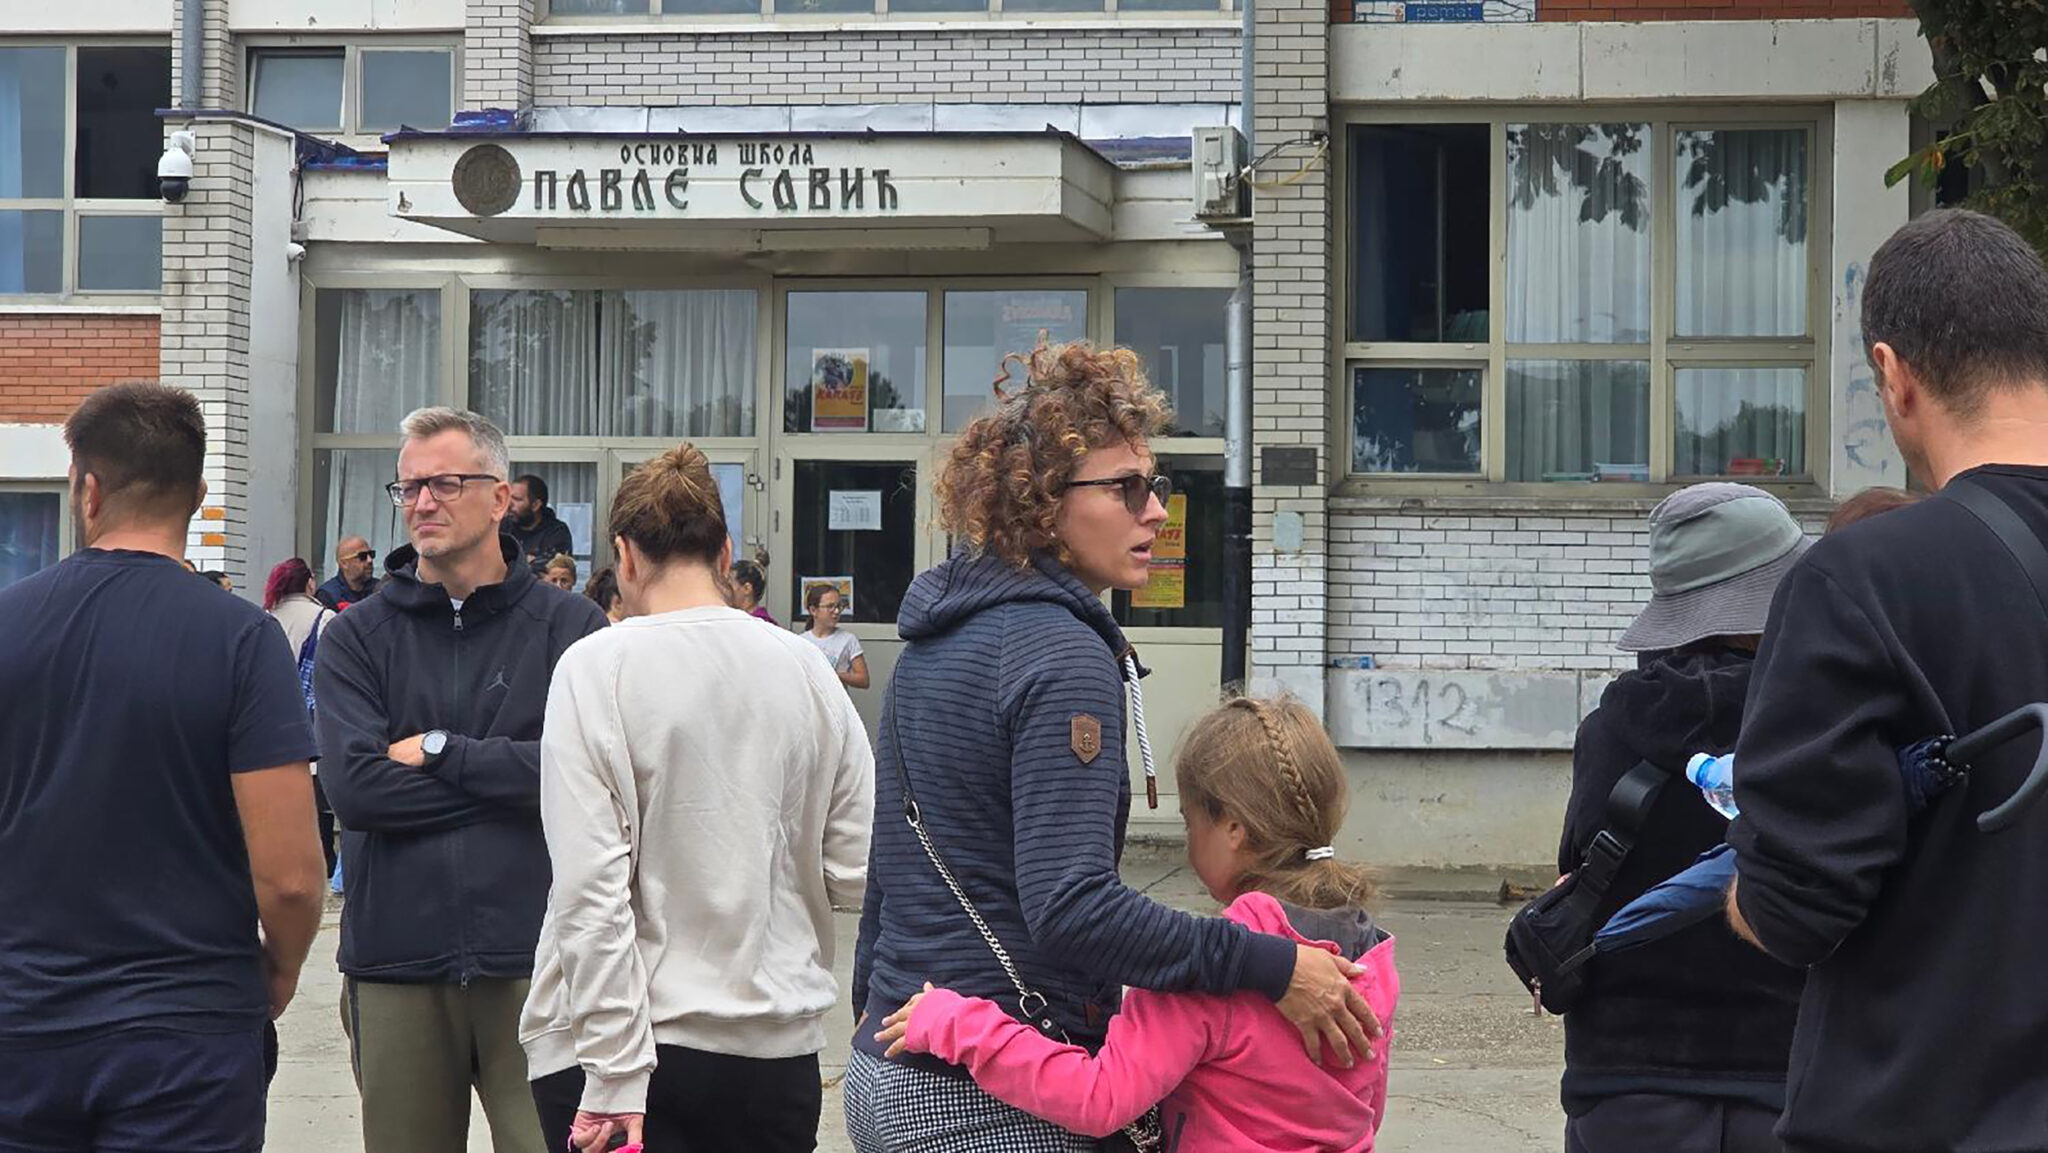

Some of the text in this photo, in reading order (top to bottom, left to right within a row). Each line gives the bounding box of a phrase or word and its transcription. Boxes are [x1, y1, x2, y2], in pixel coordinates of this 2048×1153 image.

[620, 142, 815, 166] ОСНОВНА ШКОЛА
[534, 167, 899, 211] ПАВЛЕ САВИЋ
[1355, 676, 1479, 744] 1312
